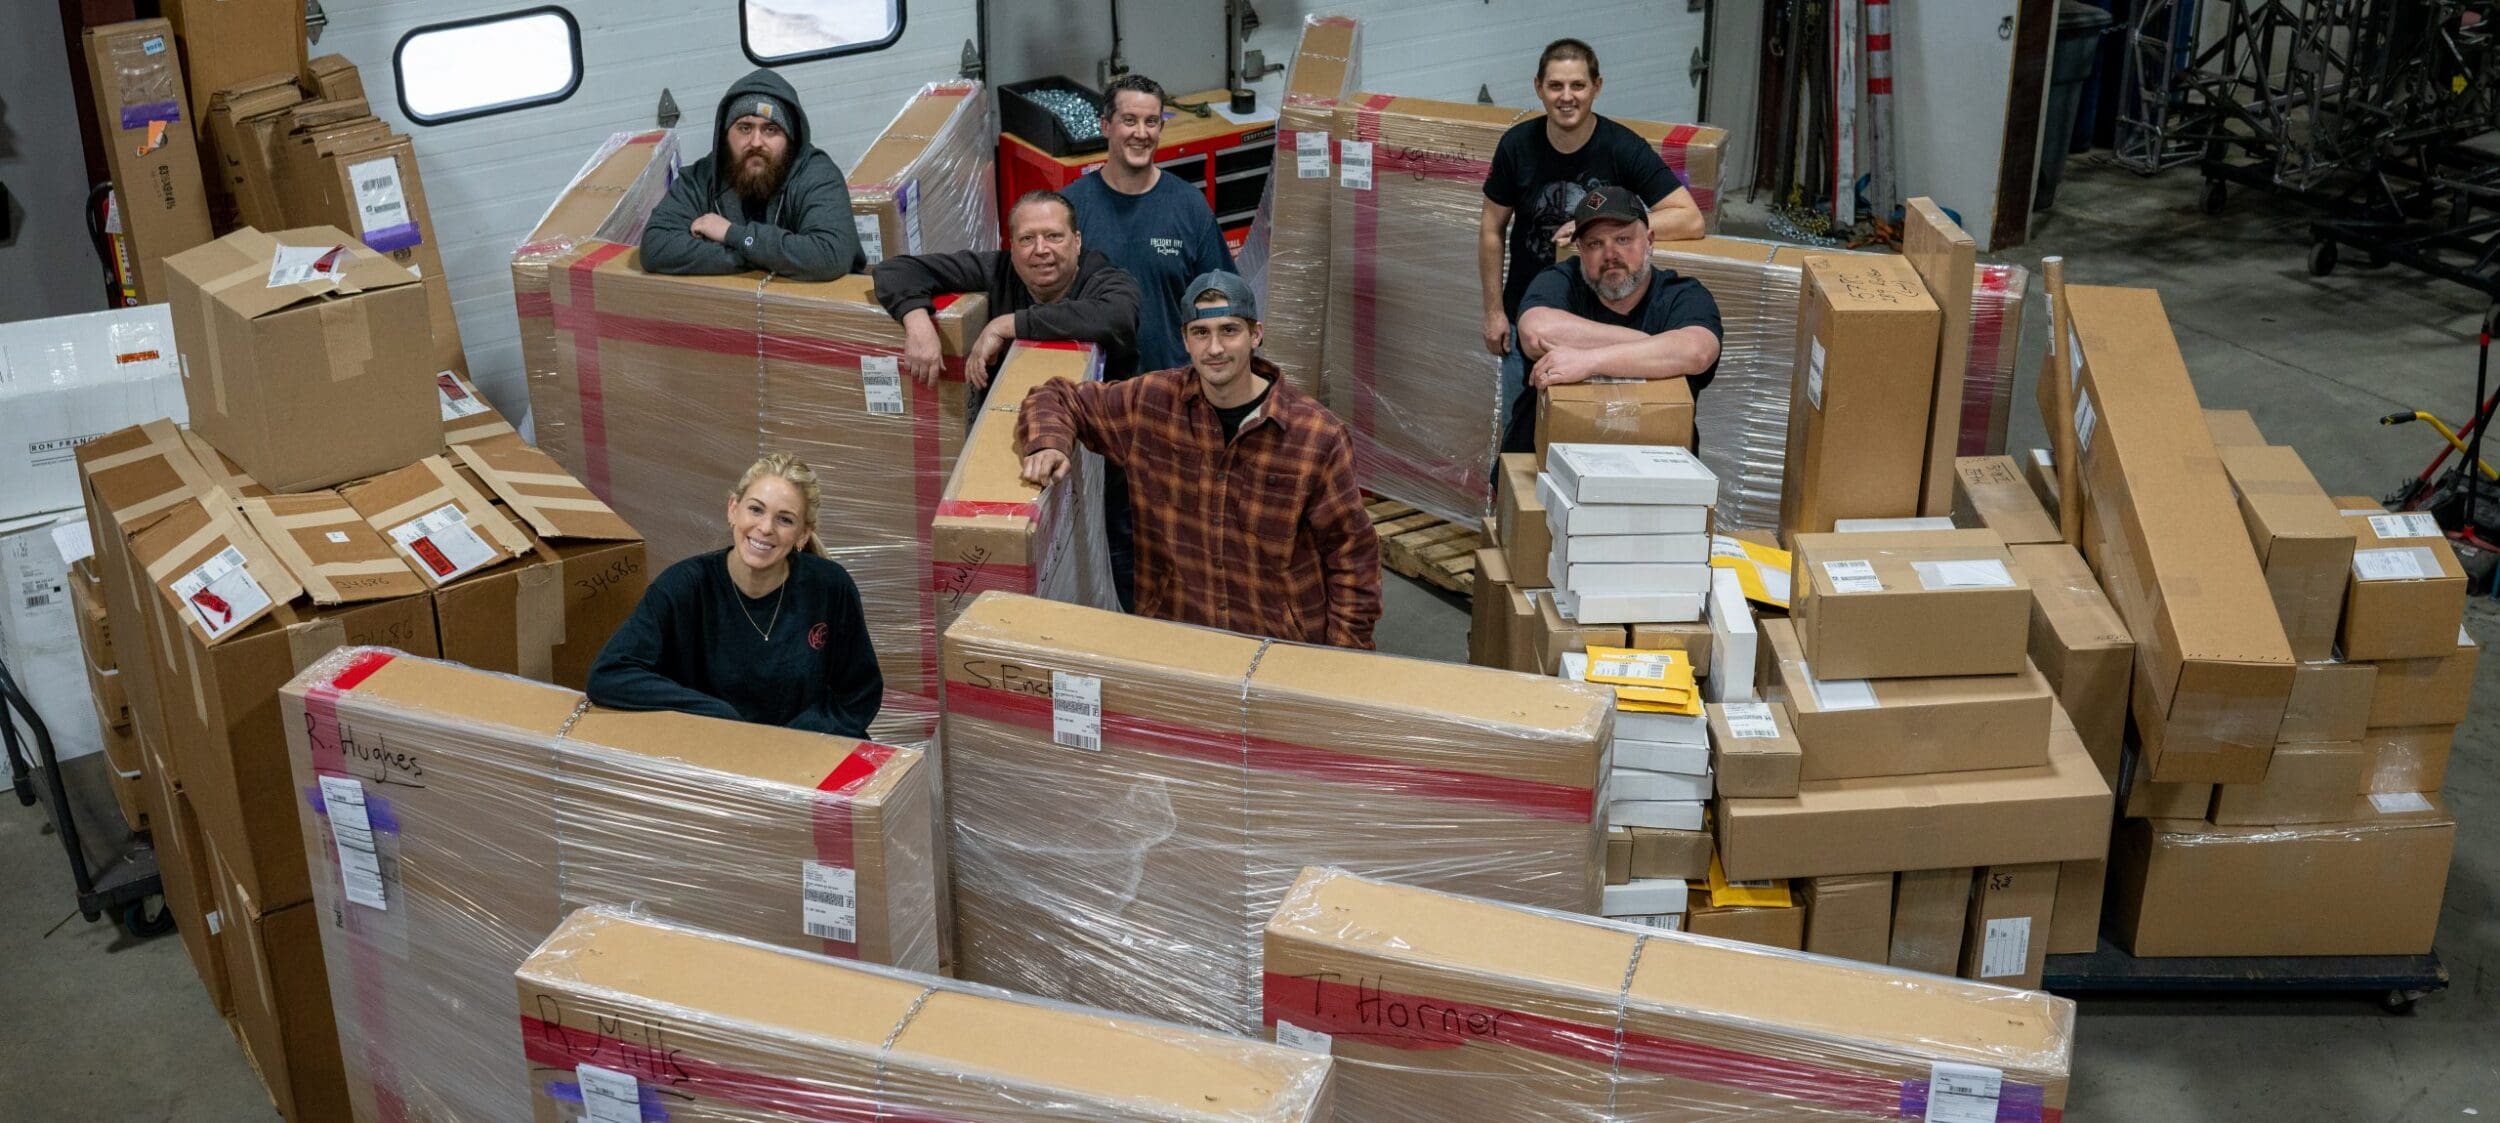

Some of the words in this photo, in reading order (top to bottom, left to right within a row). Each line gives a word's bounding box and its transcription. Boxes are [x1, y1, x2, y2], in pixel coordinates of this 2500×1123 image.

[31, 442, 54, 452] RON
[574, 555, 638, 600] 34686
[304, 711, 333, 751] R.
[338, 720, 423, 784] Hughes
[1290, 973, 1341, 1019] T.
[1356, 975, 1521, 1037] Horner
[590, 1013, 690, 1086] Mills
